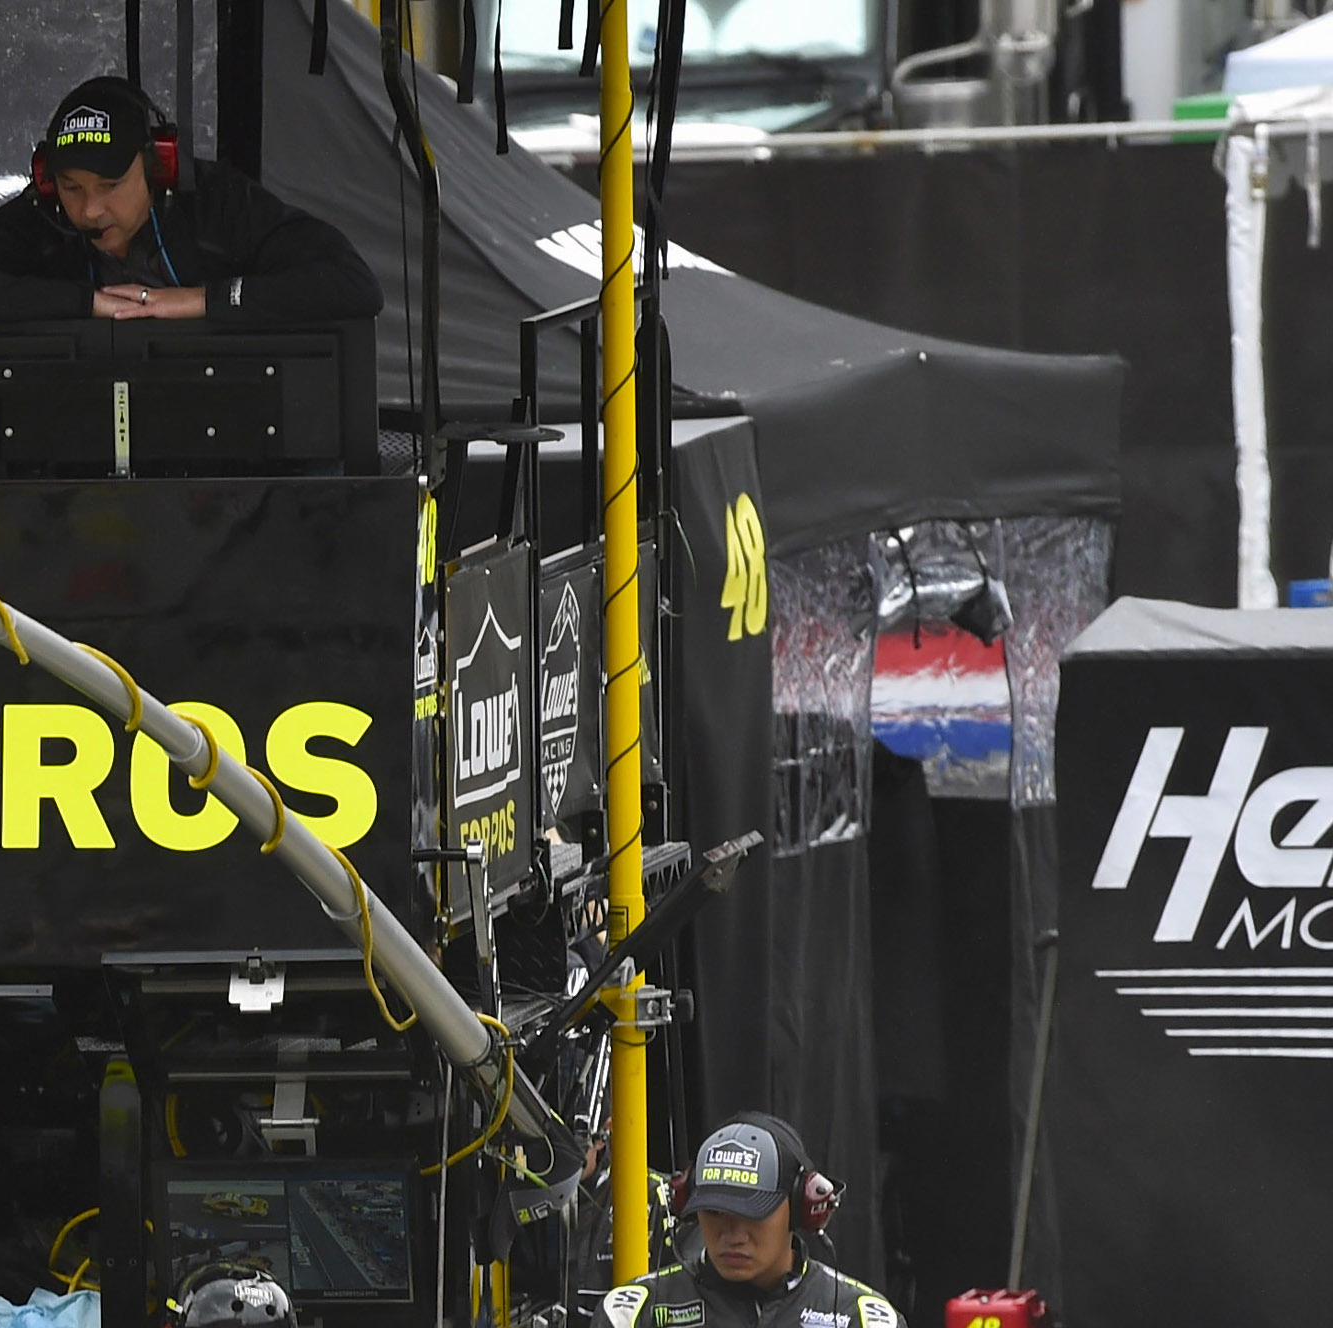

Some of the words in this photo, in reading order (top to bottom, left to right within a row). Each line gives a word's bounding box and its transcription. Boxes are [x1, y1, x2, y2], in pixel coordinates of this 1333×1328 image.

[64, 114, 104, 131] LOWE'S
[57, 133, 74, 147] FOR
[77, 131, 111, 144] PROS
[418, 496, 438, 587] 48
[720, 492, 768, 641] 48
[541, 737, 573, 761] ACING
[708, 1150, 755, 1166] LOWE'S
[702, 1168, 721, 1181] FOR
[723, 1169, 759, 1185] PROS
